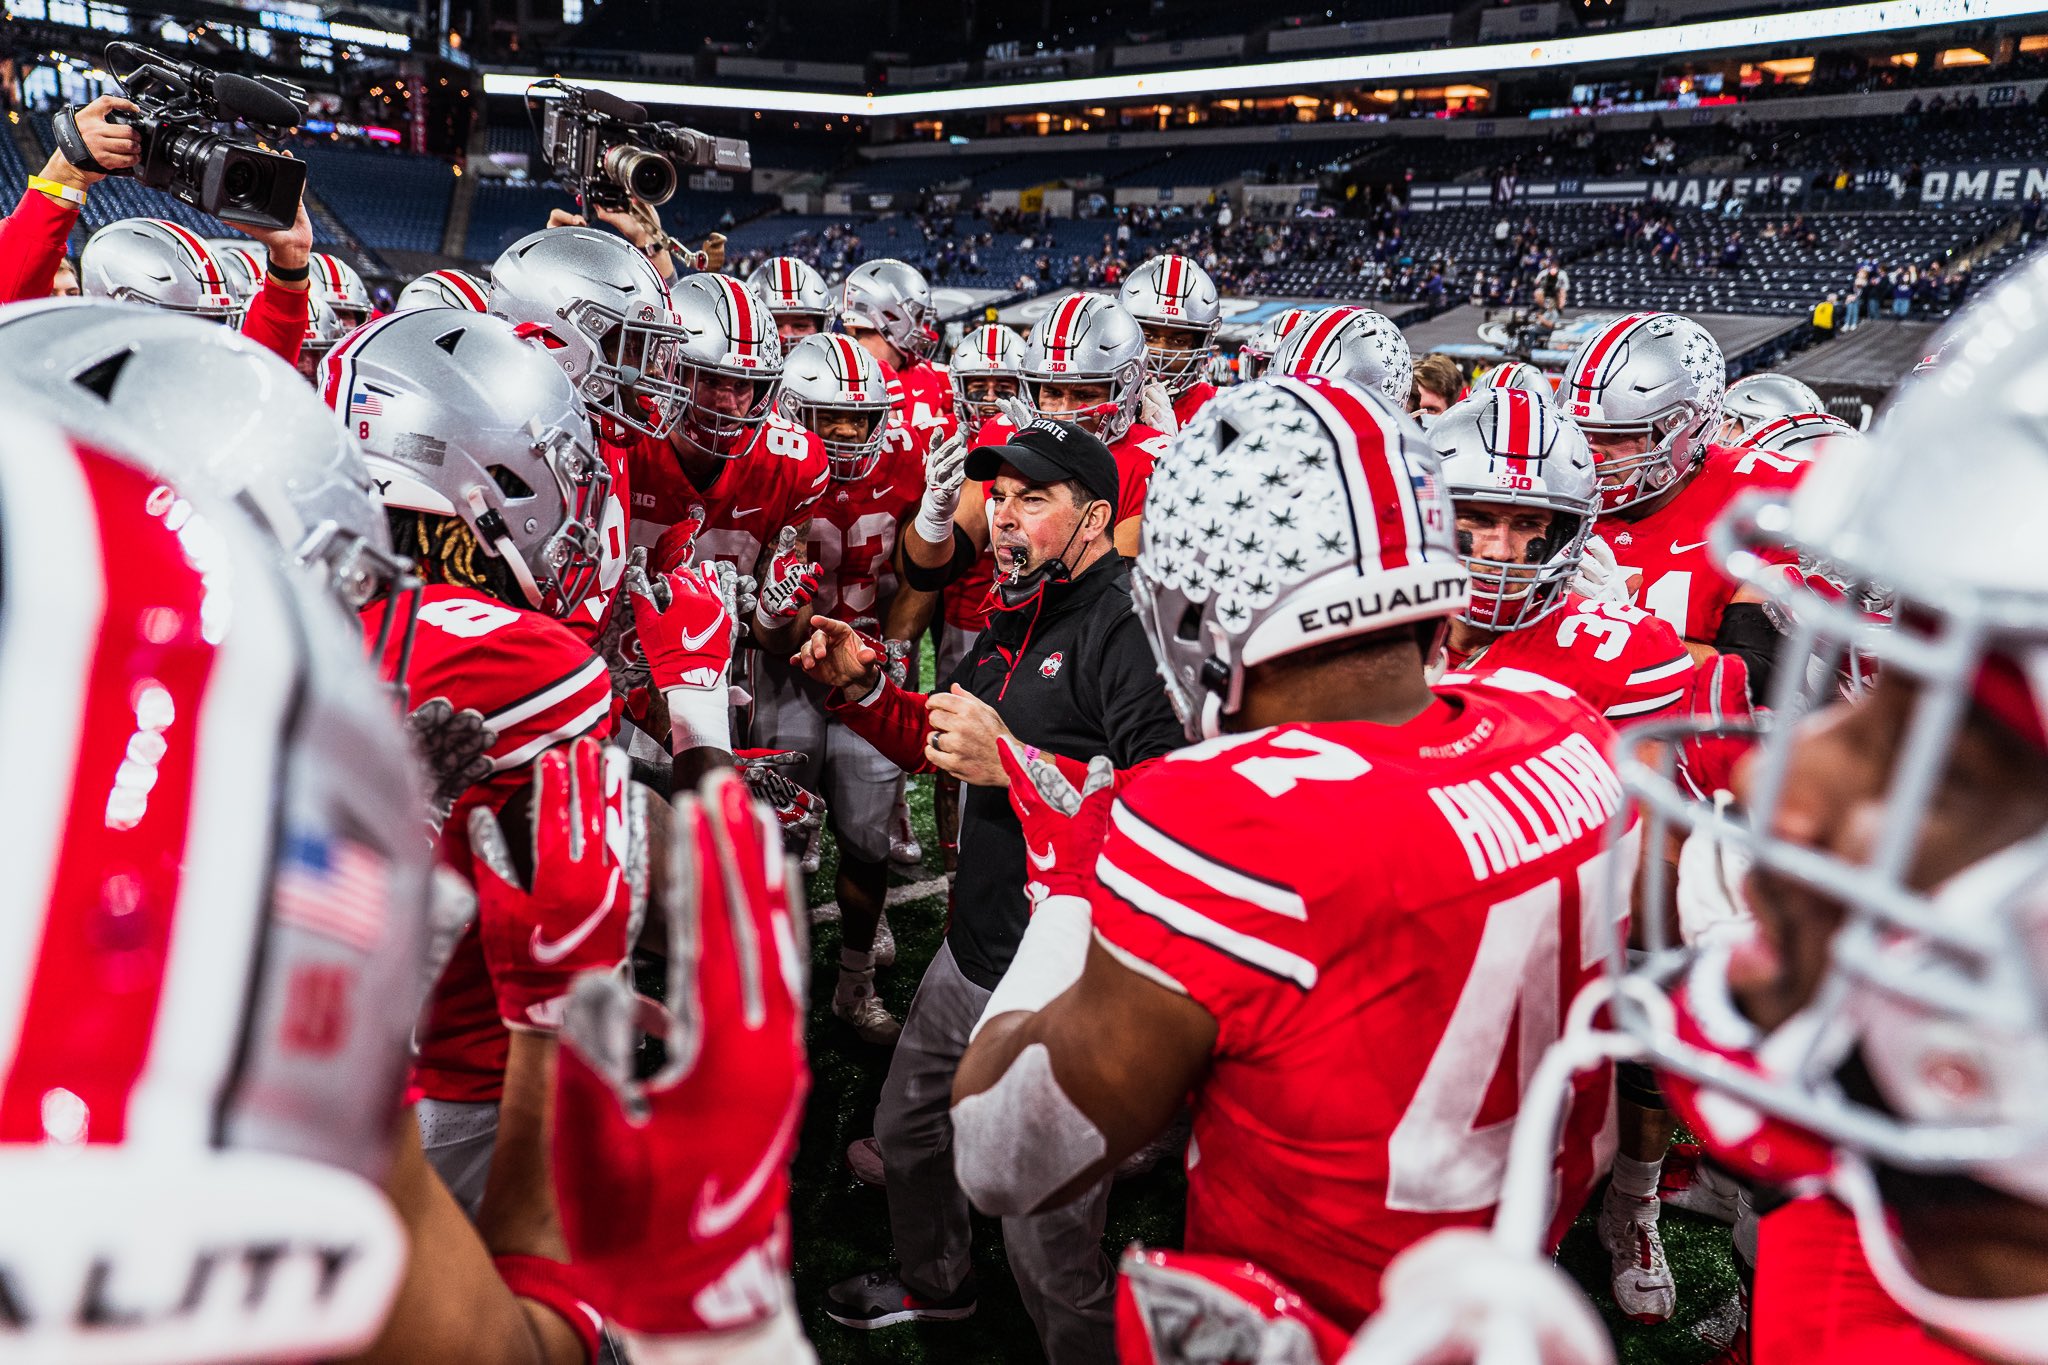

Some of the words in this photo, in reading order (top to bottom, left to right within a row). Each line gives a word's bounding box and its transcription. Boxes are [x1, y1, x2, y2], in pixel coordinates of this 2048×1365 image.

[359, 421, 369, 440] 8
[1031, 419, 1069, 442] STATE
[415, 597, 522, 639] 8
[1298, 577, 1468, 633] EQUALITY
